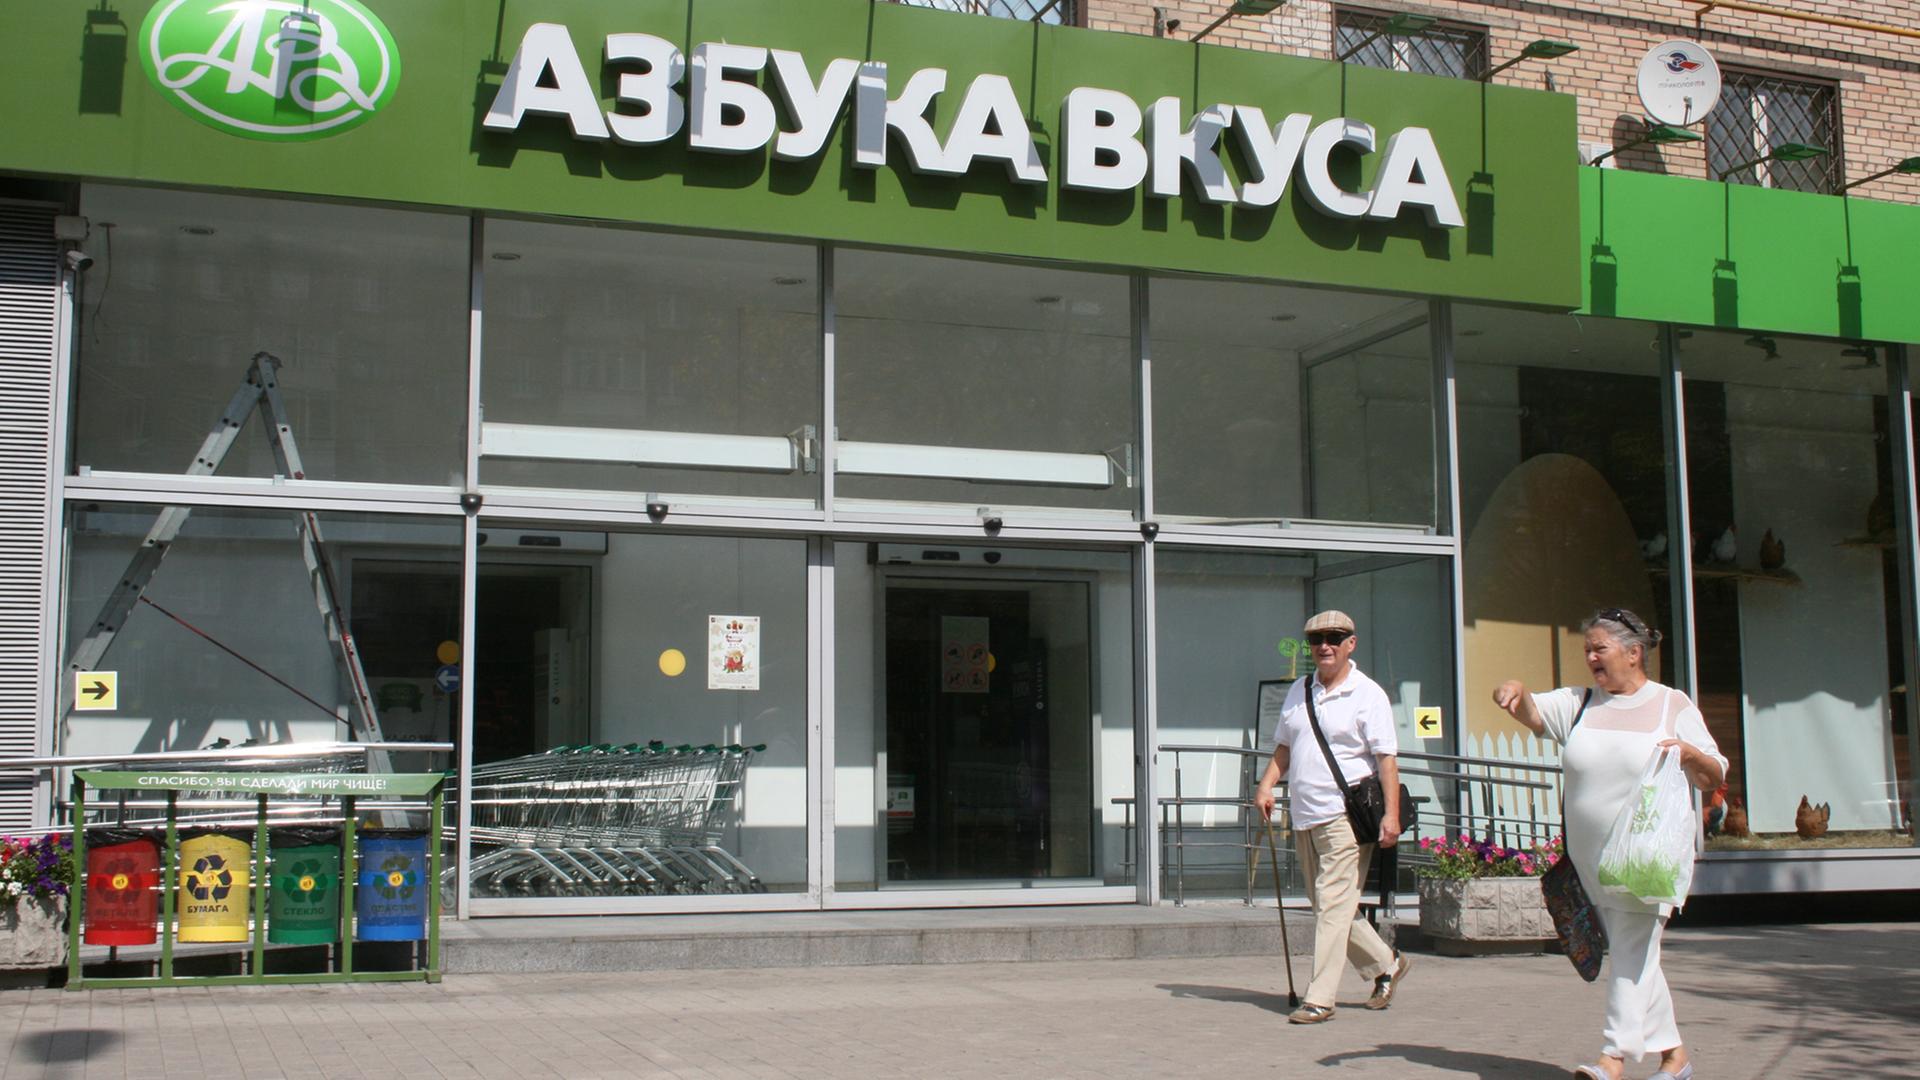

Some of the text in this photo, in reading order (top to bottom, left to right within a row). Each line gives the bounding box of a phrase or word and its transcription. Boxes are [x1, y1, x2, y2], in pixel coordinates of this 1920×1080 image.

[484, 23, 1466, 229] АЗБУКА ВКУСА
[138, 776, 387, 790] СПАСИБО, ВЫ СДЕЛАЛИ МИР ЧИЩЕ!
[187, 905, 229, 914] БУМАГА
[283, 907, 325, 915] СТЕКЛО
